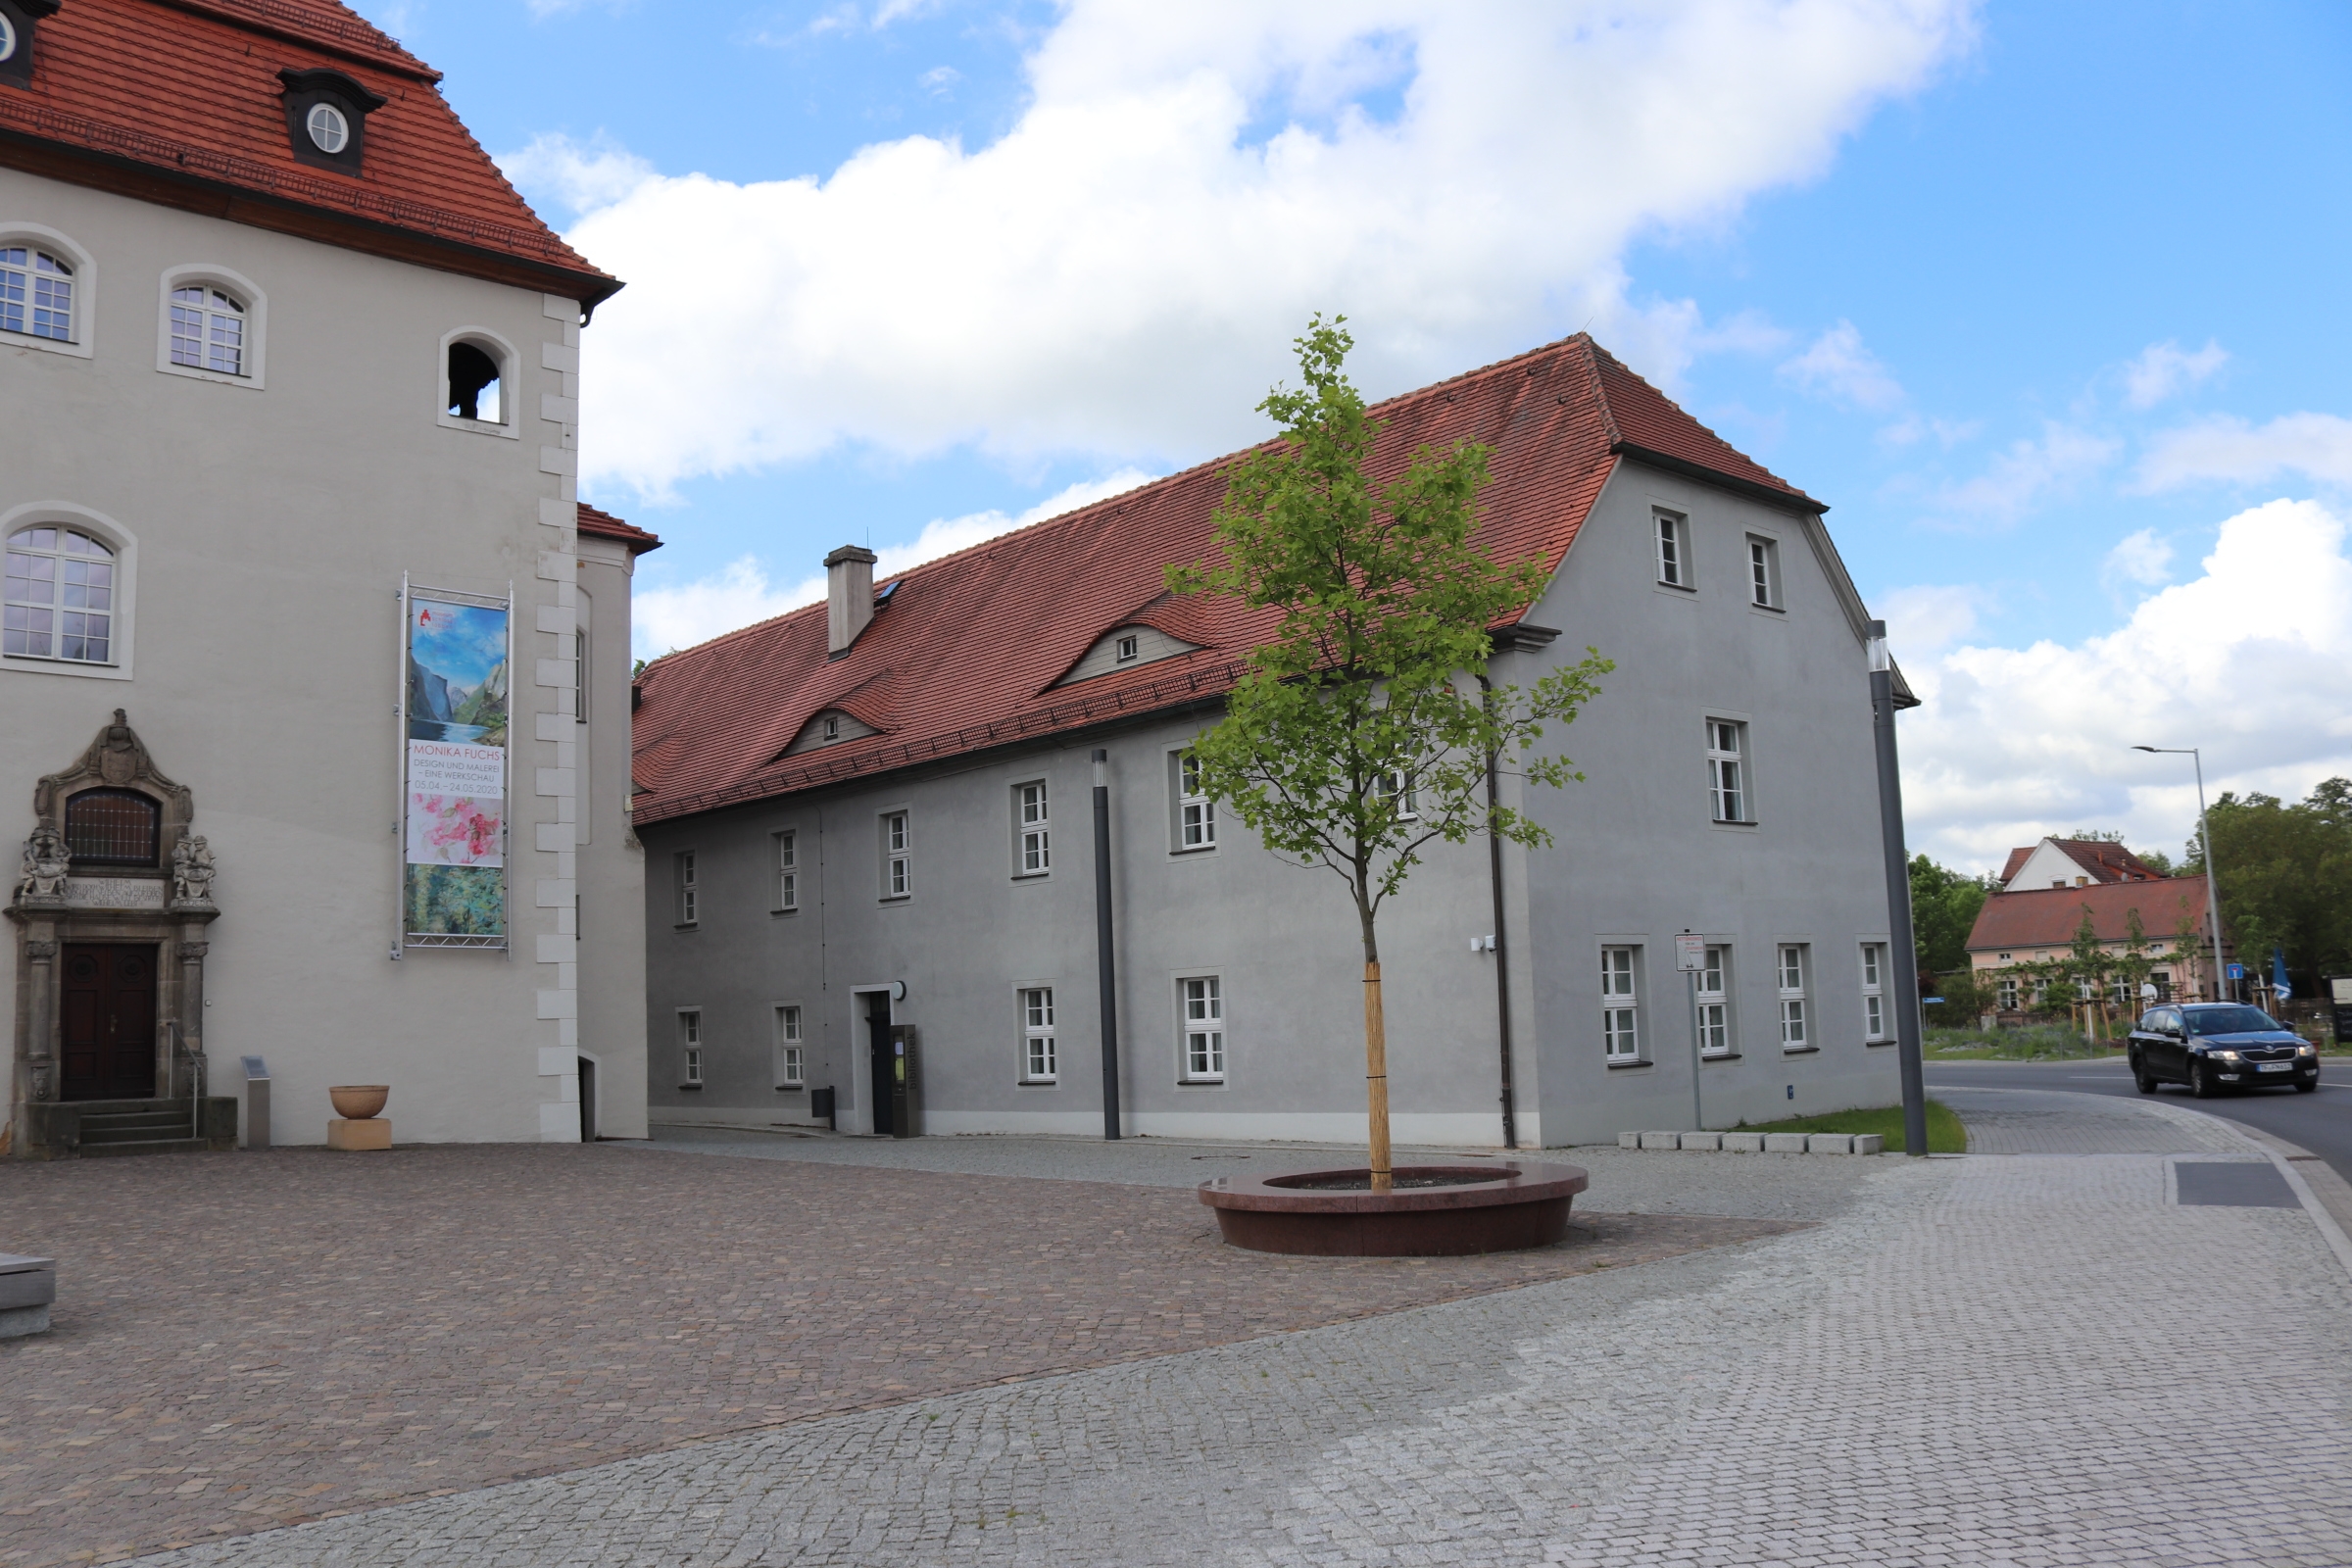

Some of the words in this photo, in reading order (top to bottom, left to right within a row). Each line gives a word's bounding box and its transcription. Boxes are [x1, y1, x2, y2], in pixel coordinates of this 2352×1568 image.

[414, 745, 462, 758] MONIKA
[465, 748, 500, 761] FUCHS
[414, 759, 445, 768] DESIGN
[447, 761, 465, 770] UND
[466, 763, 500, 773] MALEREI
[424, 769, 443, 778] EINE
[444, 771, 495, 783] WERKSCHAU
[906, 1033, 916, 1090] bibliothek
